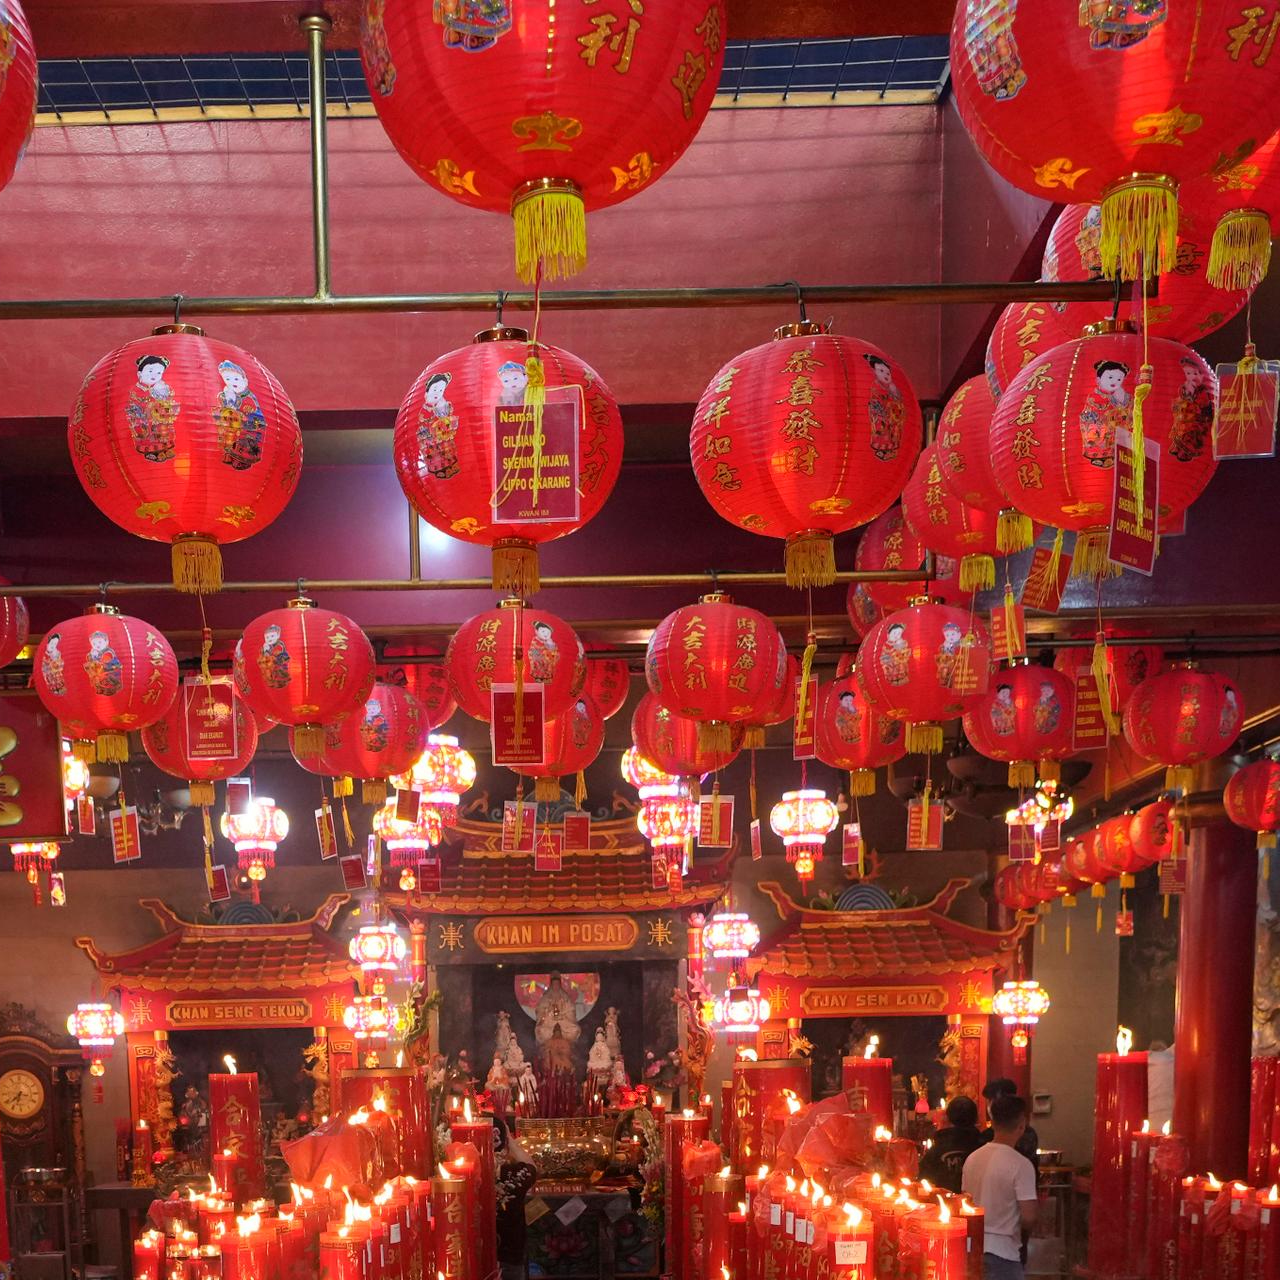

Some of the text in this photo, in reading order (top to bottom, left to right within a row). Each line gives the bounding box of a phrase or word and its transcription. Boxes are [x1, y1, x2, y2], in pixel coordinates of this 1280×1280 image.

[704, 367, 742, 491] 吉祥如意
[776, 349, 824, 477] 恭喜發財
[1008, 362, 1053, 489] 恭喜發財
[528, 476, 570, 489] CKARANG
[540, 455, 570, 467] WIJAYA
[142, 631, 167, 705] 大吉大利
[324, 617, 349, 691] 大吉大利
[682, 615, 708, 690] 大吉大利
[541, 922, 562, 945] IM
[569, 920, 627, 944] POSAT
[214, 1003, 254, 1020] SENG
[258, 1002, 307, 1019] TEKUN
